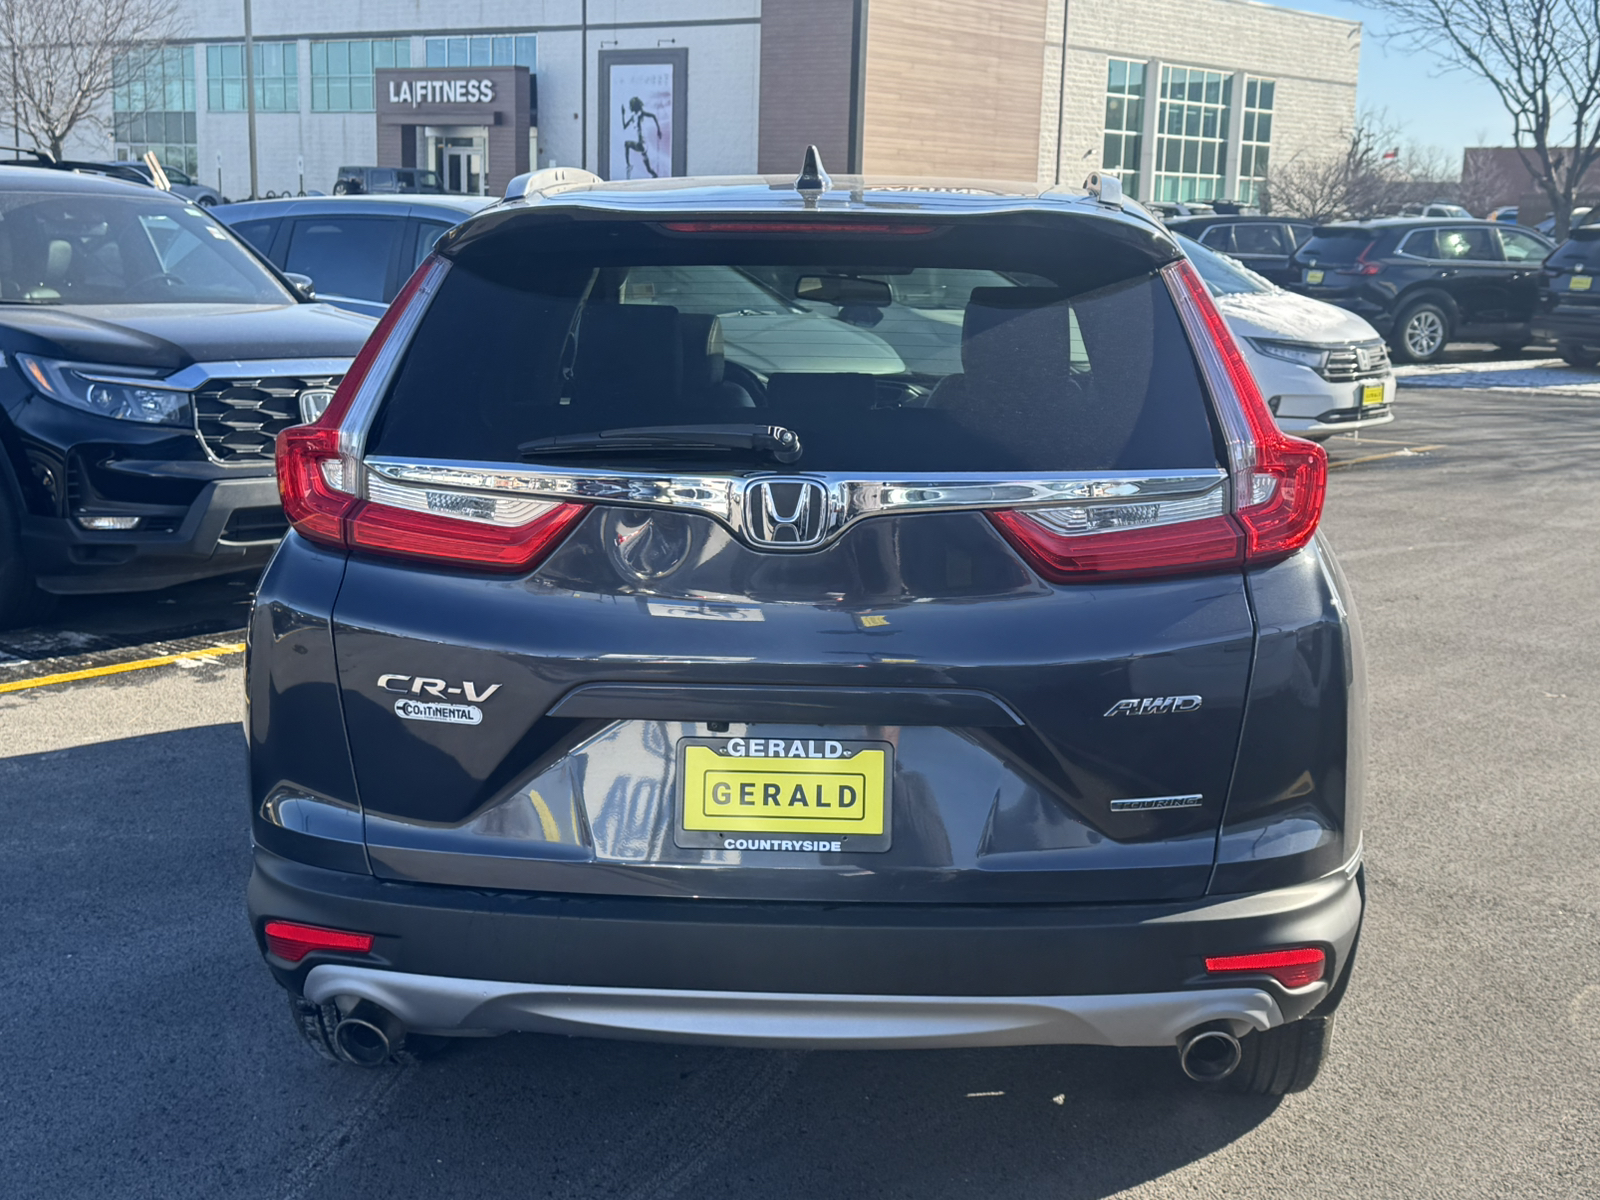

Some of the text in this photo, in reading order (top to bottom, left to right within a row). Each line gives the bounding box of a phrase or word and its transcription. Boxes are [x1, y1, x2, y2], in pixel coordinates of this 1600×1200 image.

[416, 79, 493, 103] FITNESS
[377, 673, 502, 702] CR-V
[1103, 694, 1202, 717] AWD
[727, 738, 843, 758] GERALD
[712, 782, 857, 808] GERALD
[1114, 796, 1200, 810] TOURING
[724, 838, 842, 852] COUNTRYSIDE
